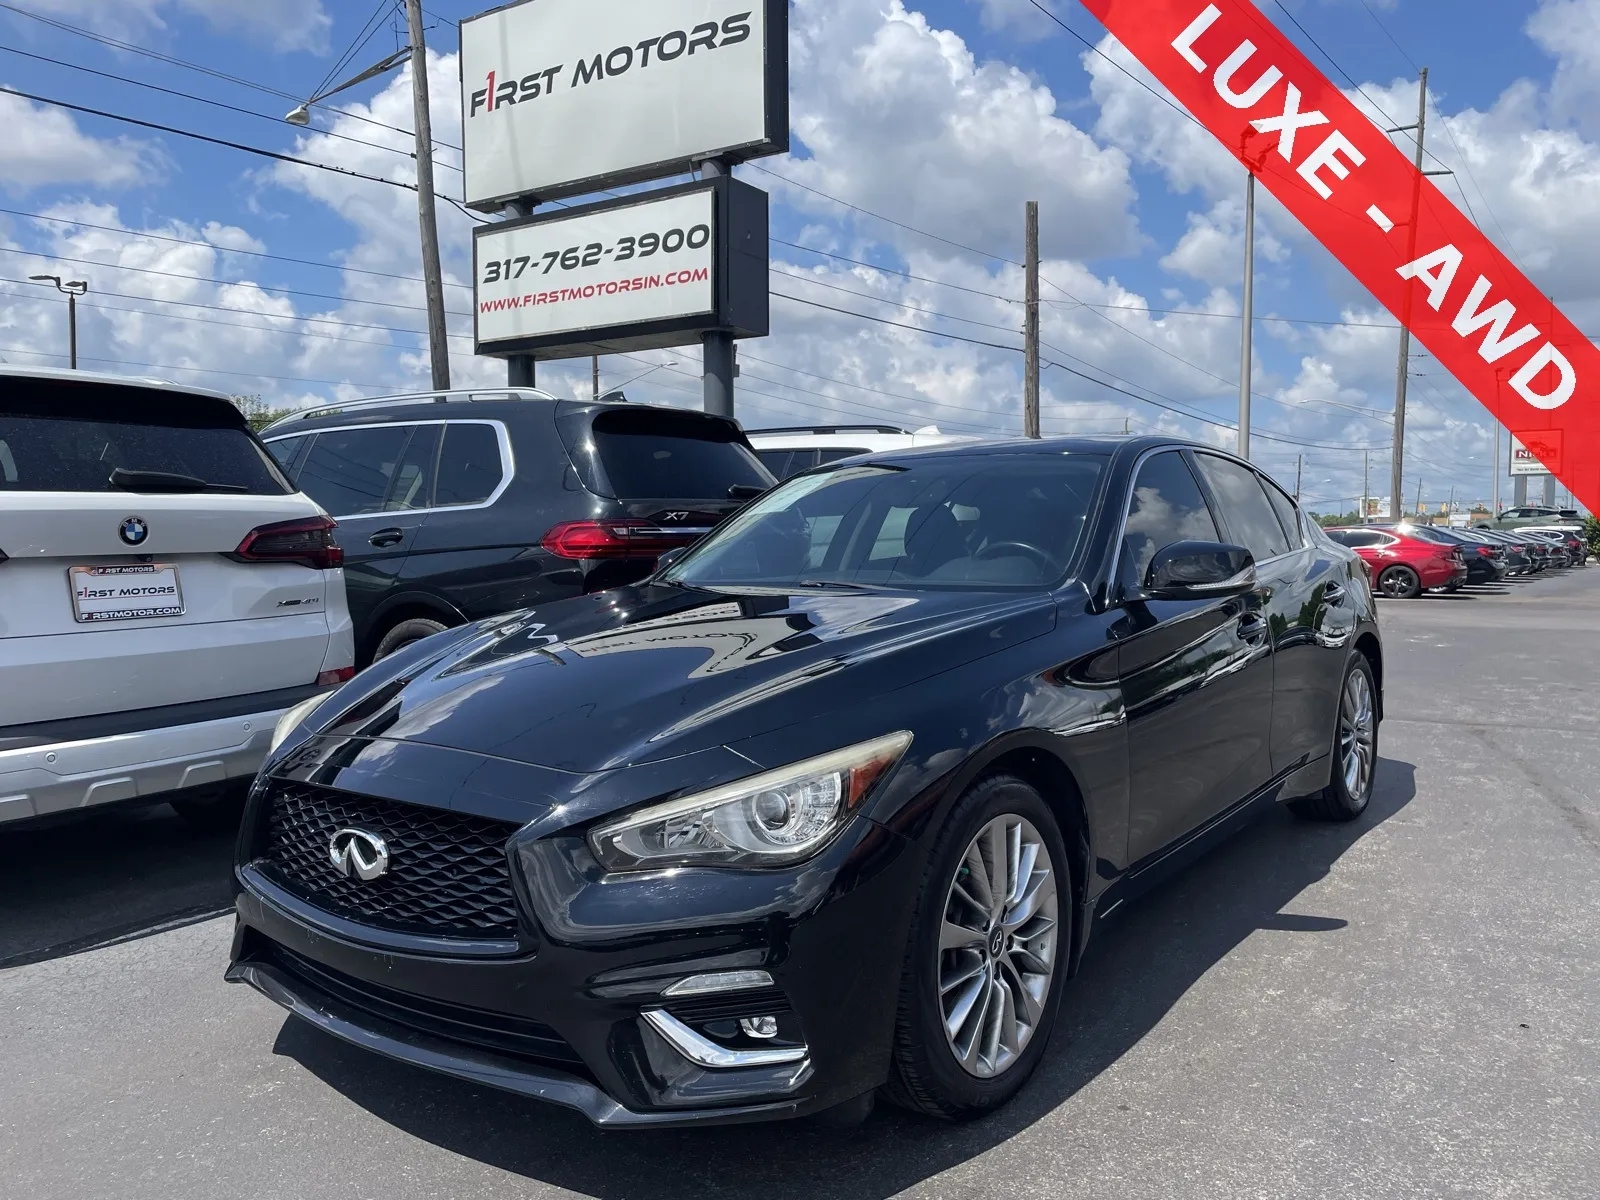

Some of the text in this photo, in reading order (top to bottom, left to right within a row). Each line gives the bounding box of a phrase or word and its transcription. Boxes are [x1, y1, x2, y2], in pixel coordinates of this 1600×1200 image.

[571, 11, 752, 88] MOTORS
[482, 223, 710, 284] 317-762-3900
[480, 267, 708, 313] WWW.FIRSTMOTORSIN.COM
[663, 511, 689, 521] X7
[119, 586, 175, 596] MOTORS
